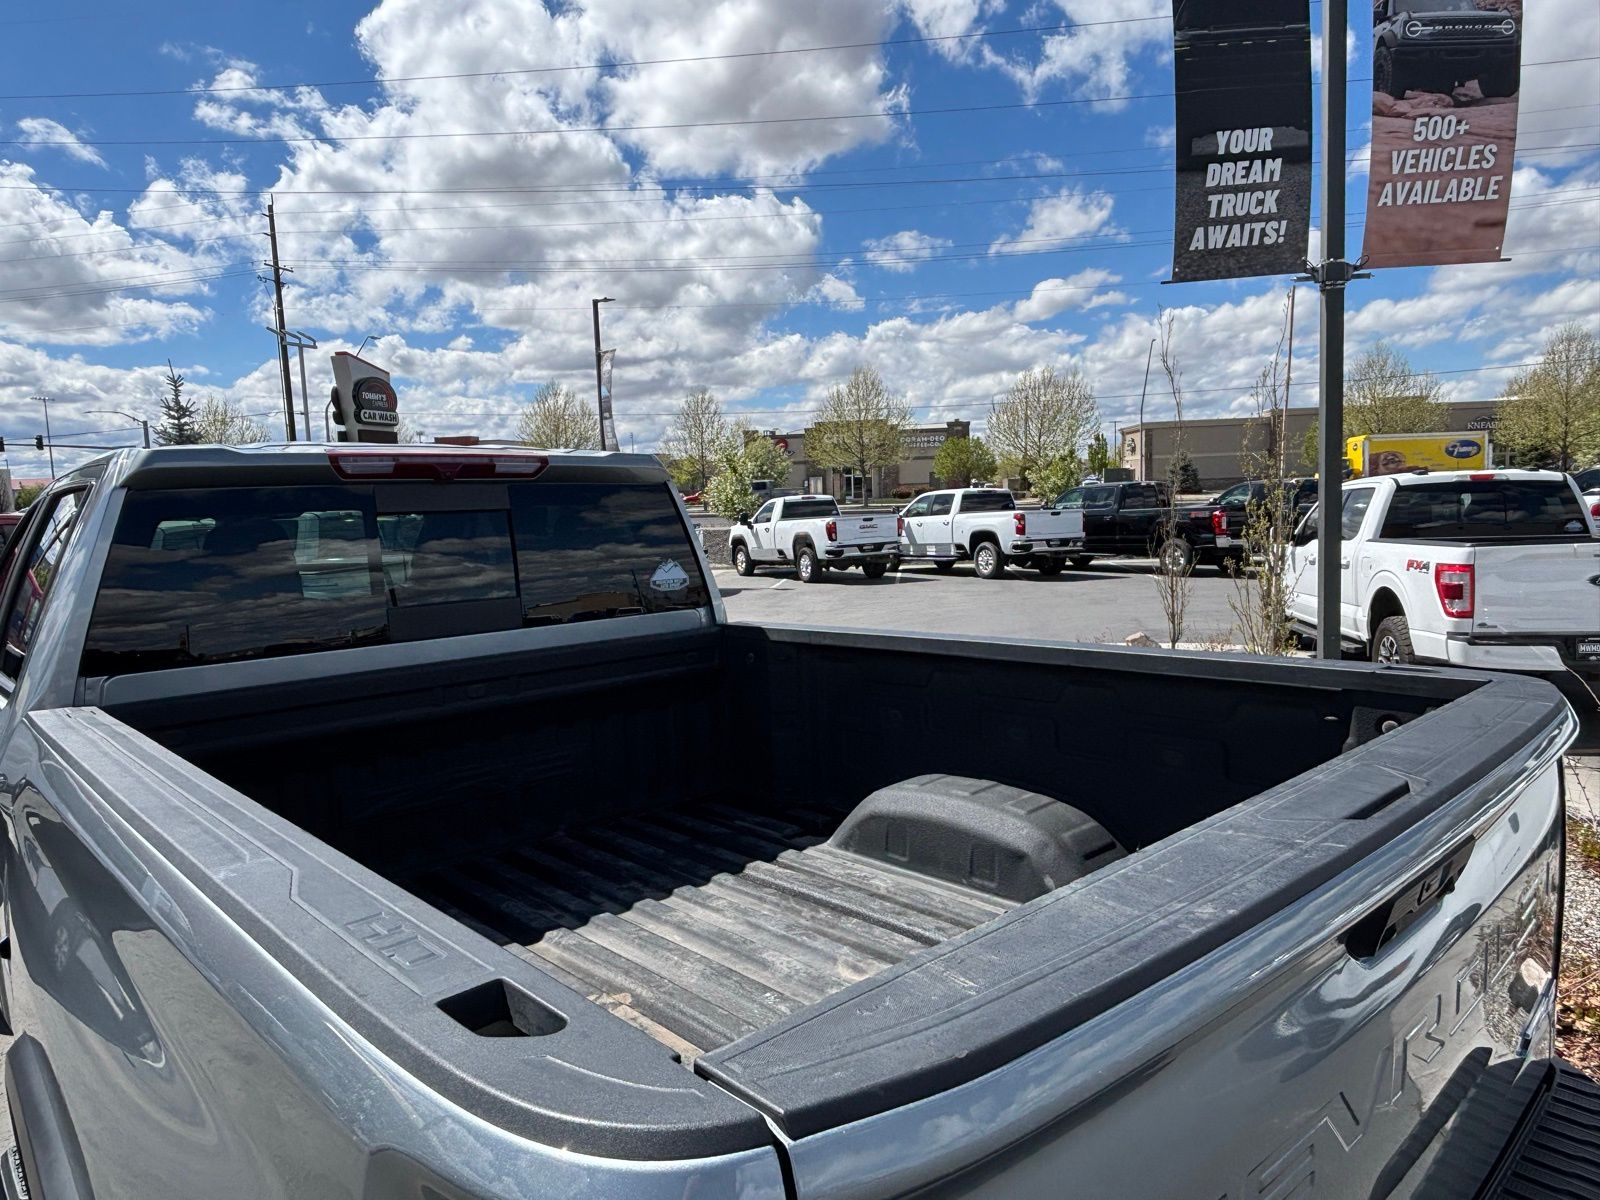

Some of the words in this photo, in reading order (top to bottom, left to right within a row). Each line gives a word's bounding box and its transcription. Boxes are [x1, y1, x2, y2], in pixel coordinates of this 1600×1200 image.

[1216, 127, 1274, 155] YOUR
[1413, 114, 1470, 142] 500+
[1205, 157, 1283, 188] DREAM
[1391, 143, 1498, 175] VEHICLES
[1207, 189, 1281, 219] TRUCK
[1376, 175, 1504, 207] AVAILABLE
[1188, 220, 1288, 251] AWAITS!
[363, 411, 376, 420] CAR
[378, 412, 397, 422] WASH
[1406, 559, 1430, 571] FX4
